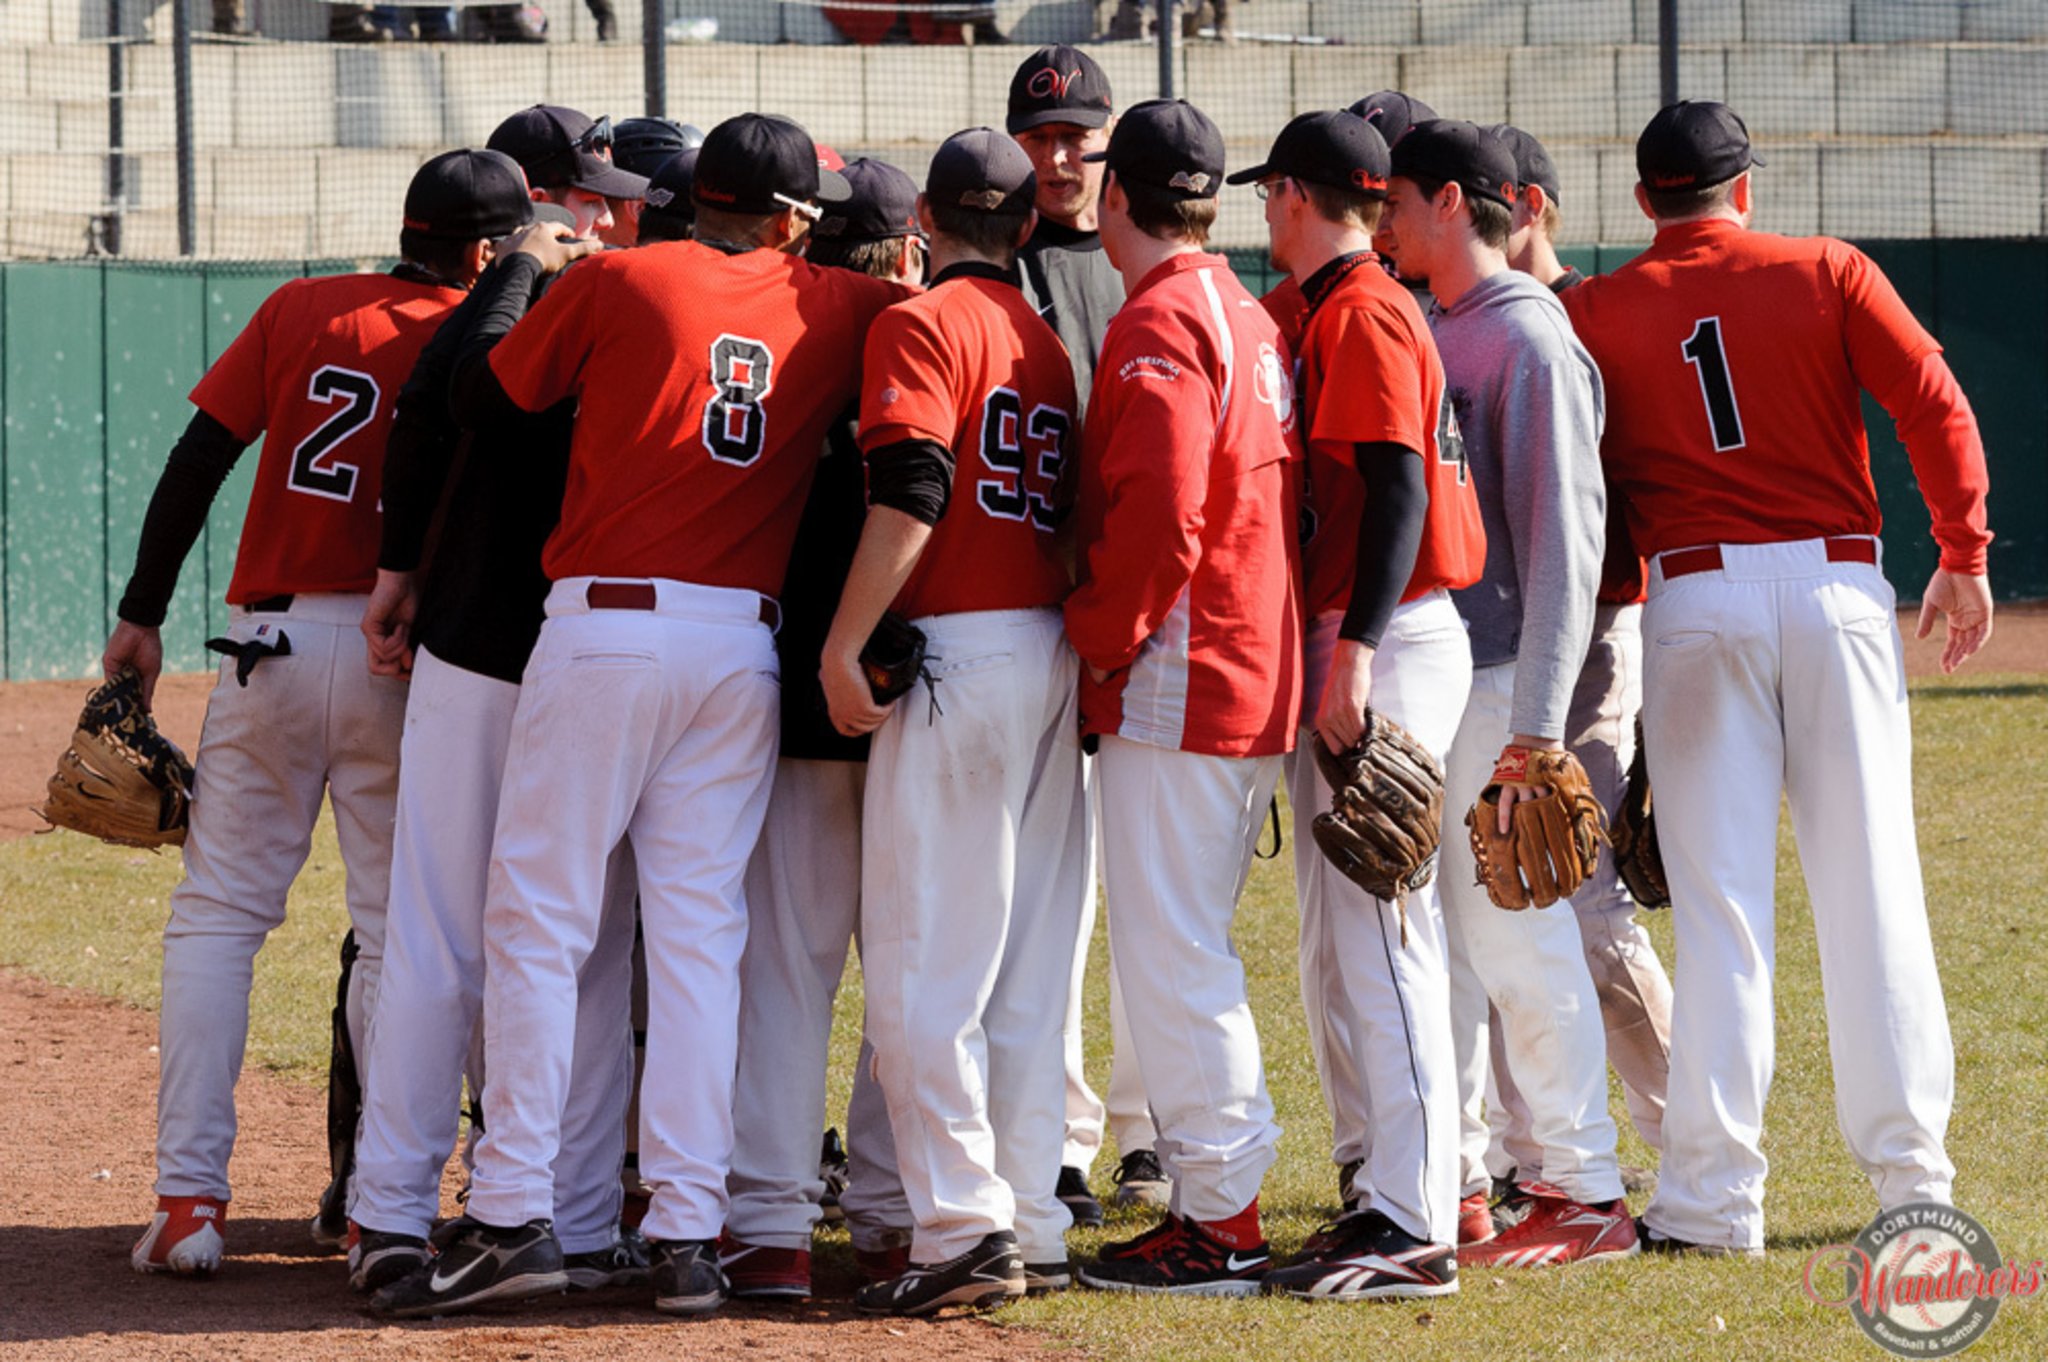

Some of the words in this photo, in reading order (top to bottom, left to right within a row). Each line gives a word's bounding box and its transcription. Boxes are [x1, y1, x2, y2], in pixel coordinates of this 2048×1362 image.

[287, 364, 396, 513] 2
[702, 332, 774, 468] 8
[1680, 315, 1746, 453] 1
[976, 384, 1070, 533] 93
